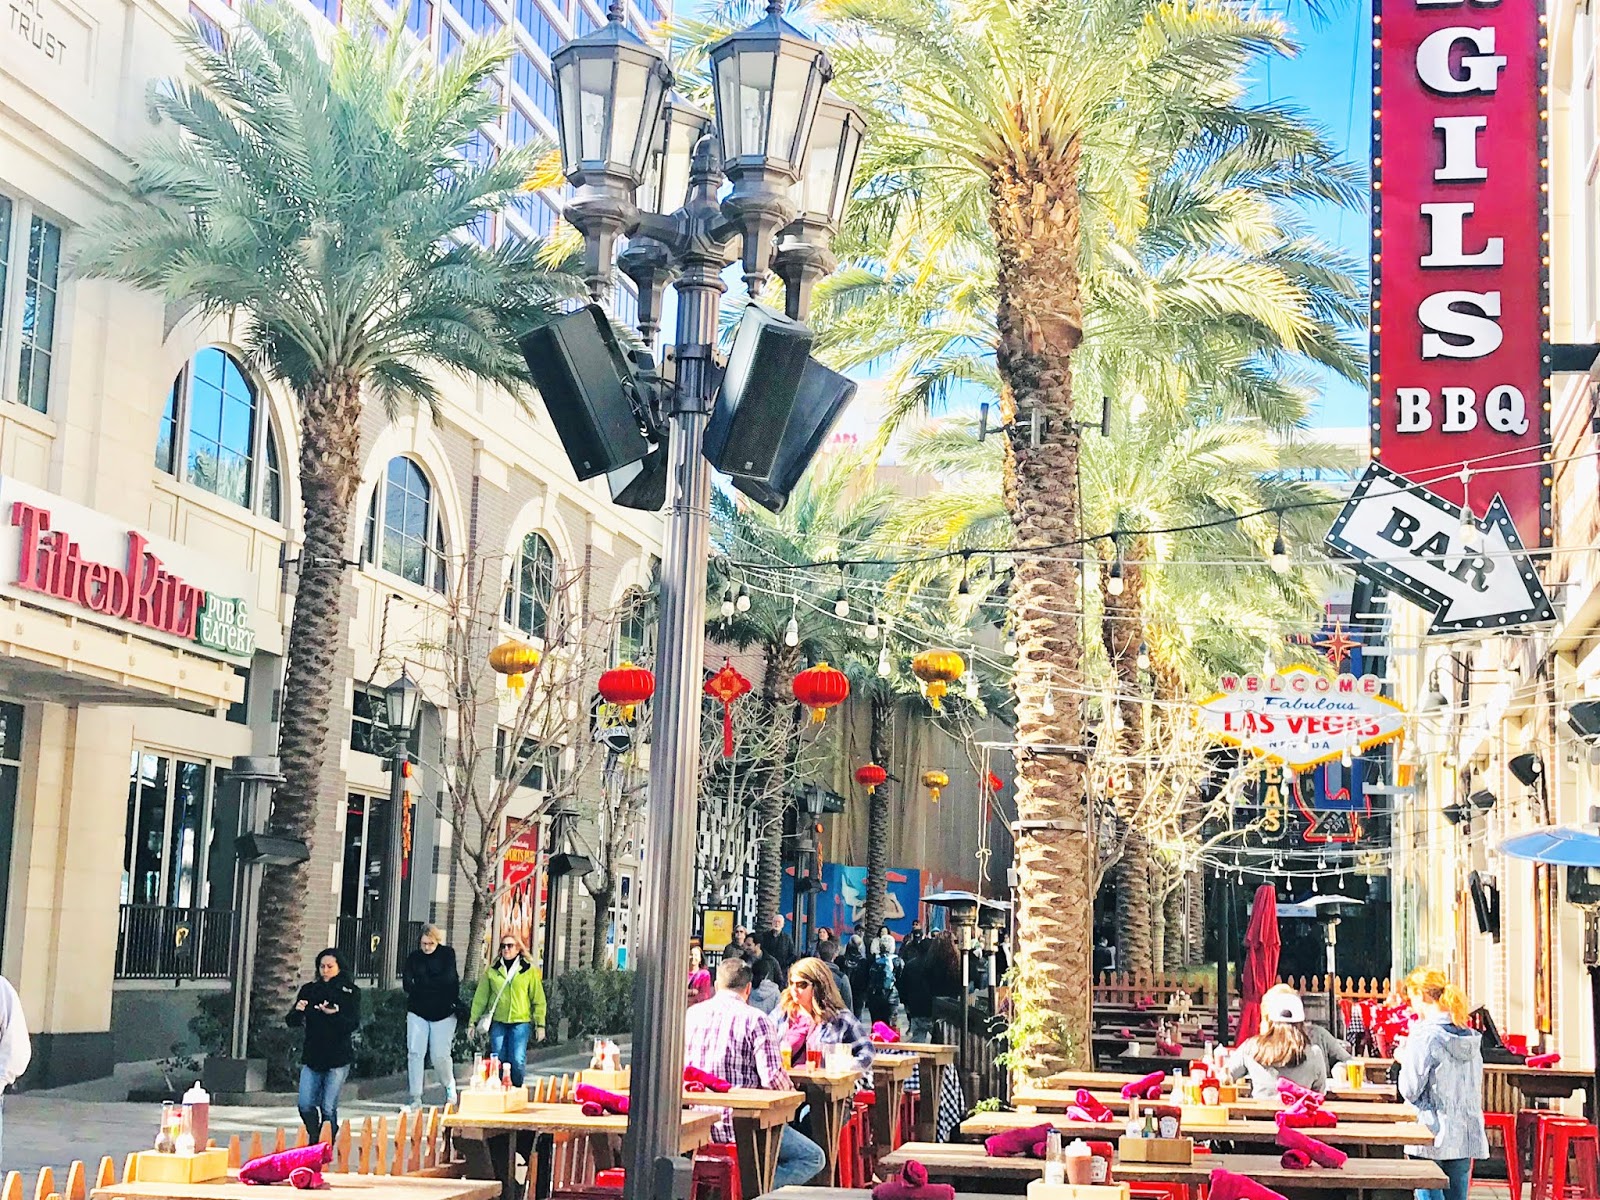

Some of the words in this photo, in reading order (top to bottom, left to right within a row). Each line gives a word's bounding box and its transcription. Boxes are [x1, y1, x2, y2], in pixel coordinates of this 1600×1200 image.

[9, 3, 67, 65] TRUST
[1415, 0, 1508, 361] GILS
[1396, 384, 1530, 436] BBQ
[1376, 506, 1496, 593] BAR
[207, 594, 235, 626] PUB
[236, 600, 248, 629] &
[1221, 676, 1376, 694] WELCOME
[1263, 696, 1360, 711] Fabulous
[1224, 711, 1275, 734] LAS
[1285, 714, 1381, 737] VEGAS
